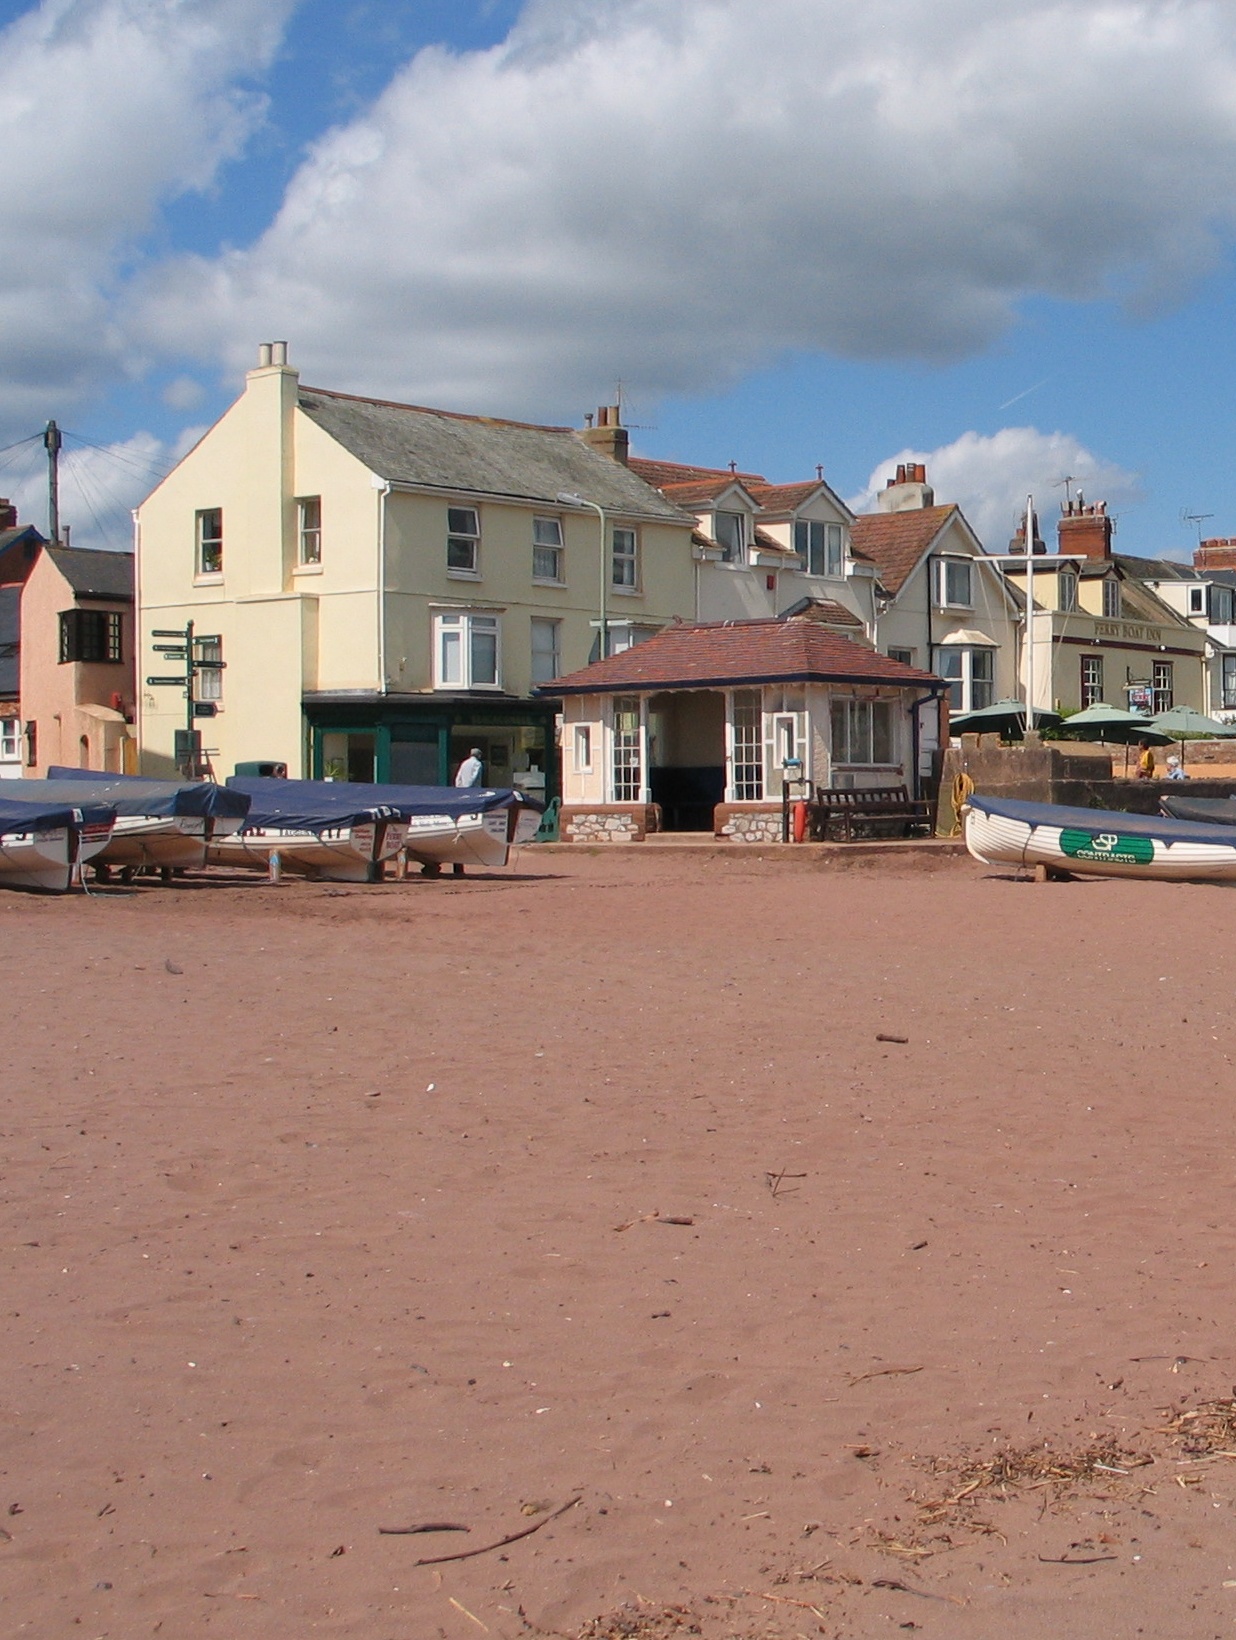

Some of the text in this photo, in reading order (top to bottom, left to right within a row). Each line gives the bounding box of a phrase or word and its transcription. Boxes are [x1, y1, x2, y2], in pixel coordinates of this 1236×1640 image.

[1094, 621, 1163, 642] FERRY BOAT INN
